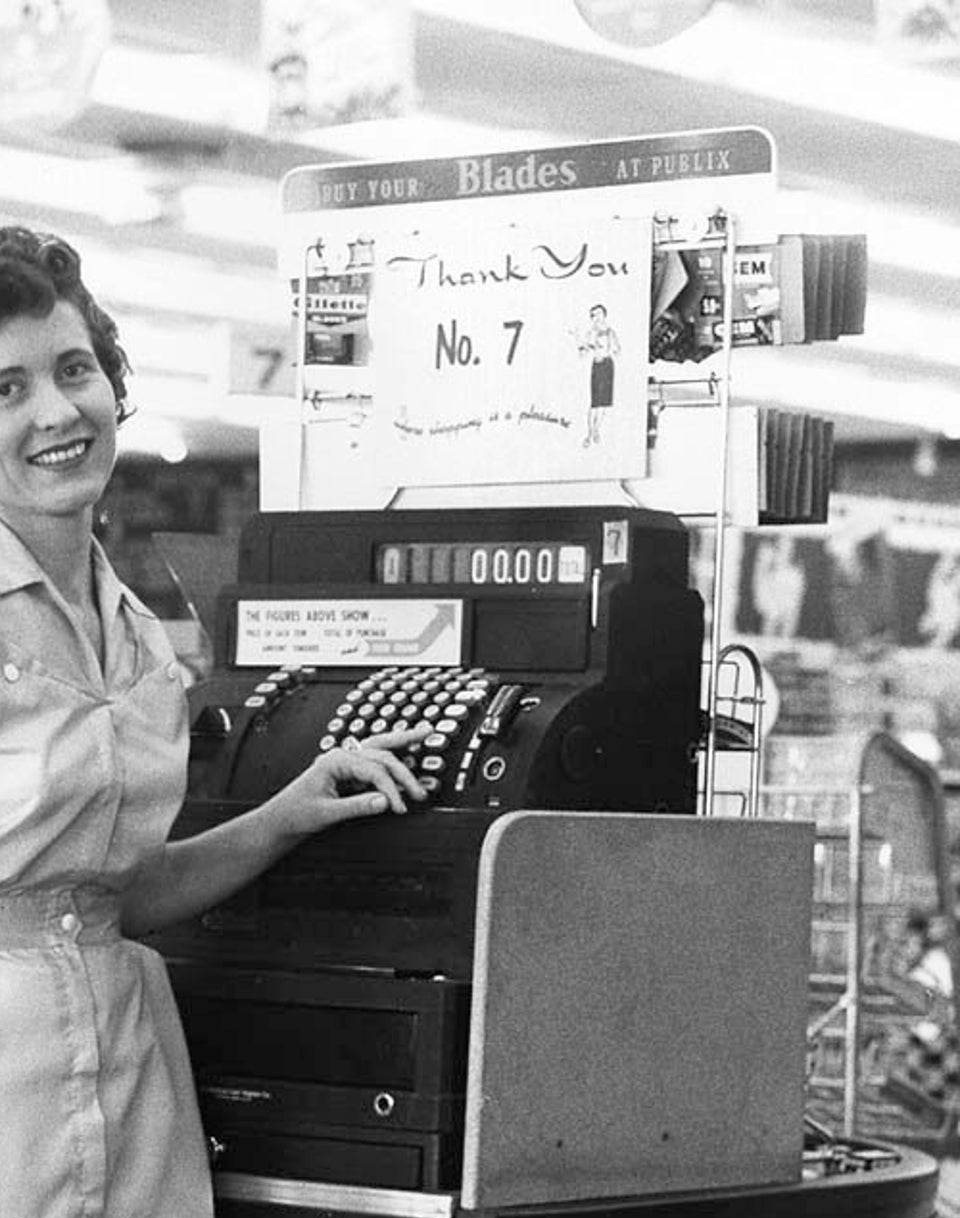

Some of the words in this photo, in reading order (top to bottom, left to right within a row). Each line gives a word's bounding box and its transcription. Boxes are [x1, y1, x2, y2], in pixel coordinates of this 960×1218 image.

[321, 181, 358, 202] BUY
[367, 178, 418, 200] YOUR
[455, 153, 578, 196] Blades
[616, 158, 642, 180] AT
[649, 149, 730, 176] PUBLIX
[386, 253, 529, 287] Thank
[533, 243, 629, 280] You
[435, 318, 481, 370] No.
[502, 319, 525, 366] 7
[254, 346, 285, 390] 7
[606, 529, 621, 557] 7
[245, 609, 261, 622] THE
[265, 609, 301, 622] FIGURES
[306, 609, 337, 622] ABOVE
